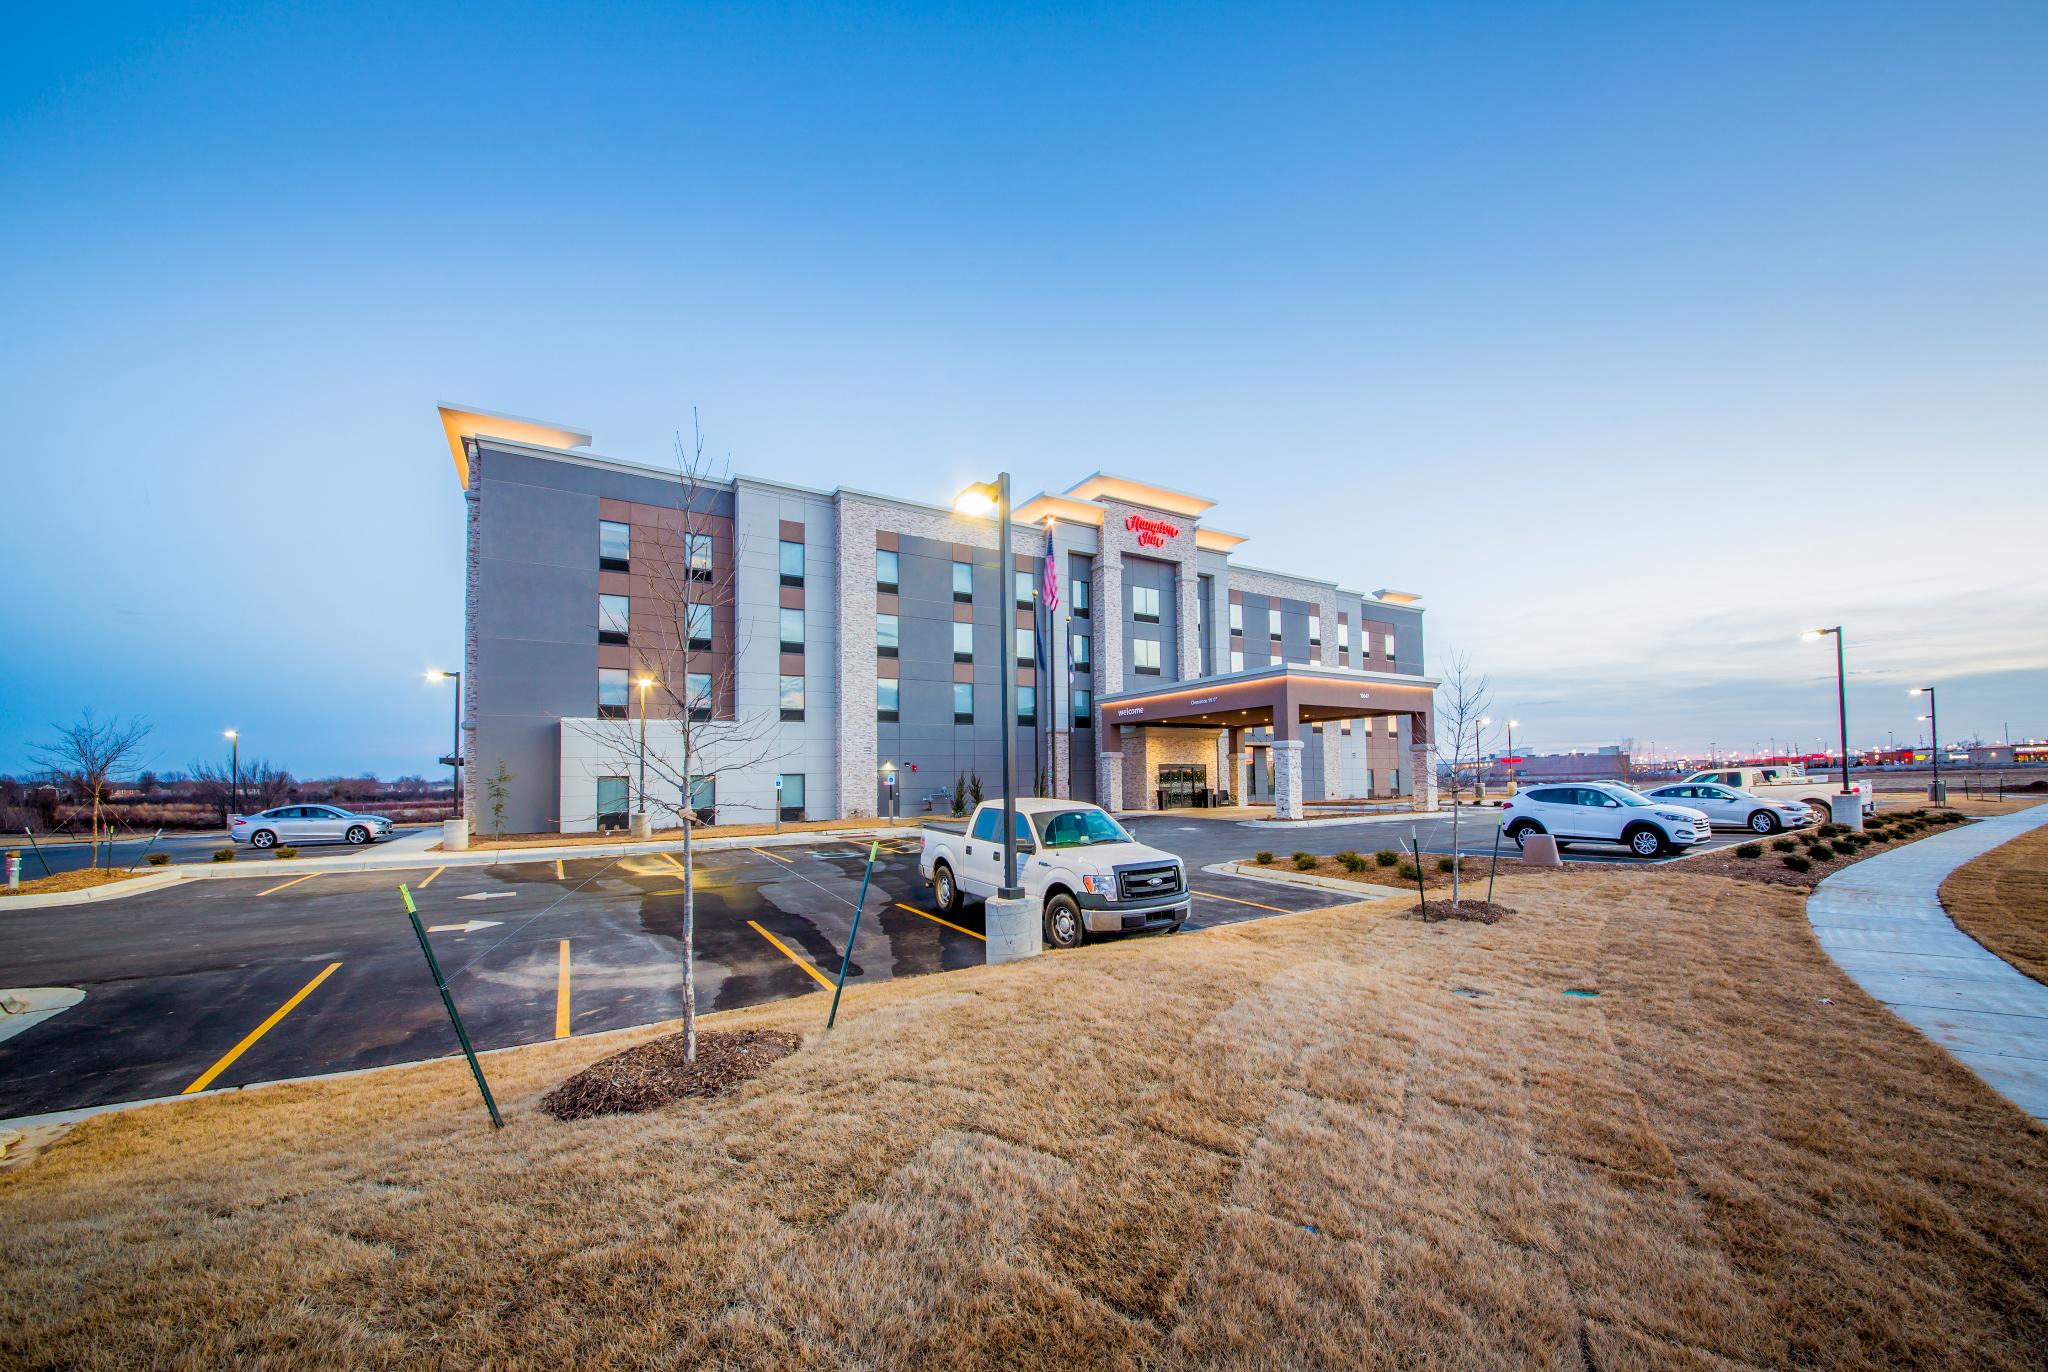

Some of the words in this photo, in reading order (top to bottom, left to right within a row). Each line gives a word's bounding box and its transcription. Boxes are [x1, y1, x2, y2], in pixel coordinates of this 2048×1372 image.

[1125, 514, 1179, 538] Hampton
[1138, 531, 1164, 548] Inn
[1117, 707, 1144, 717] welcome
